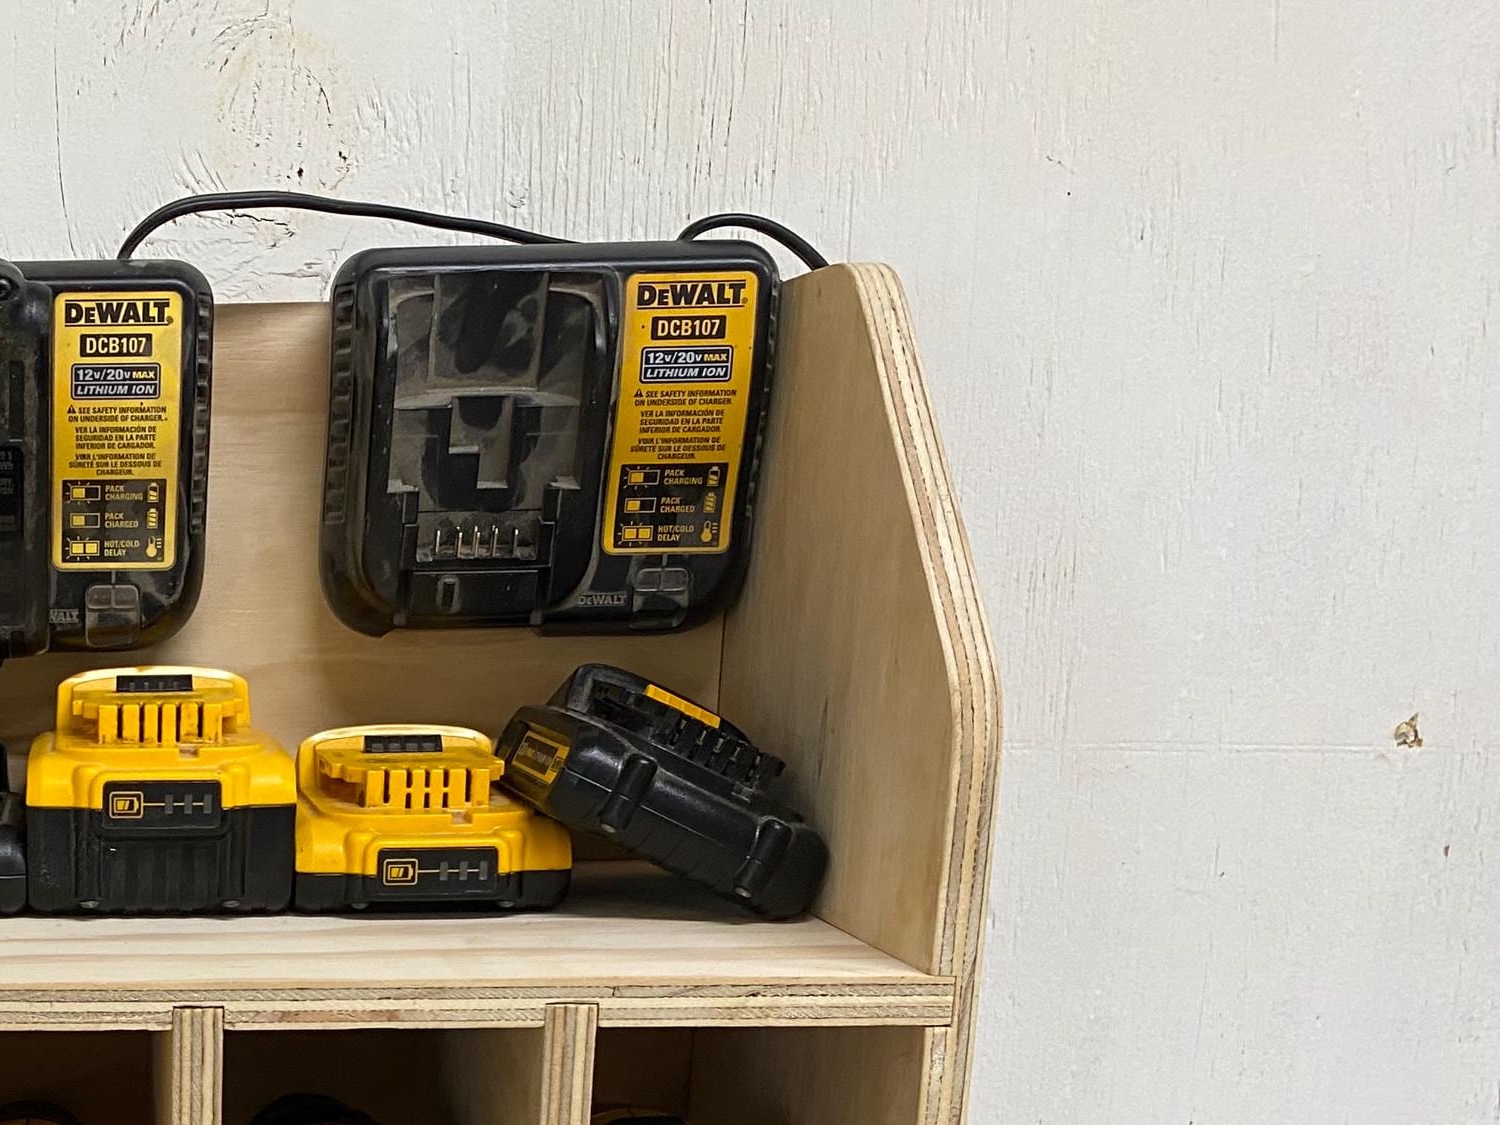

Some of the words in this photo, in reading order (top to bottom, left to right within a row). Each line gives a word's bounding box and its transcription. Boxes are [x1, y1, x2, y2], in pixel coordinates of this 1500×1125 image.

[658, 320, 721, 336] DCB107
[86, 338, 146, 353] DCB107
[646, 368, 699, 377] LITHIUM
[702, 367, 726, 376] ION
[77, 386, 128, 395] LITHIUM
[658, 525, 694, 533] HOT/COLD
[104, 540, 139, 548] HOT/COLD
